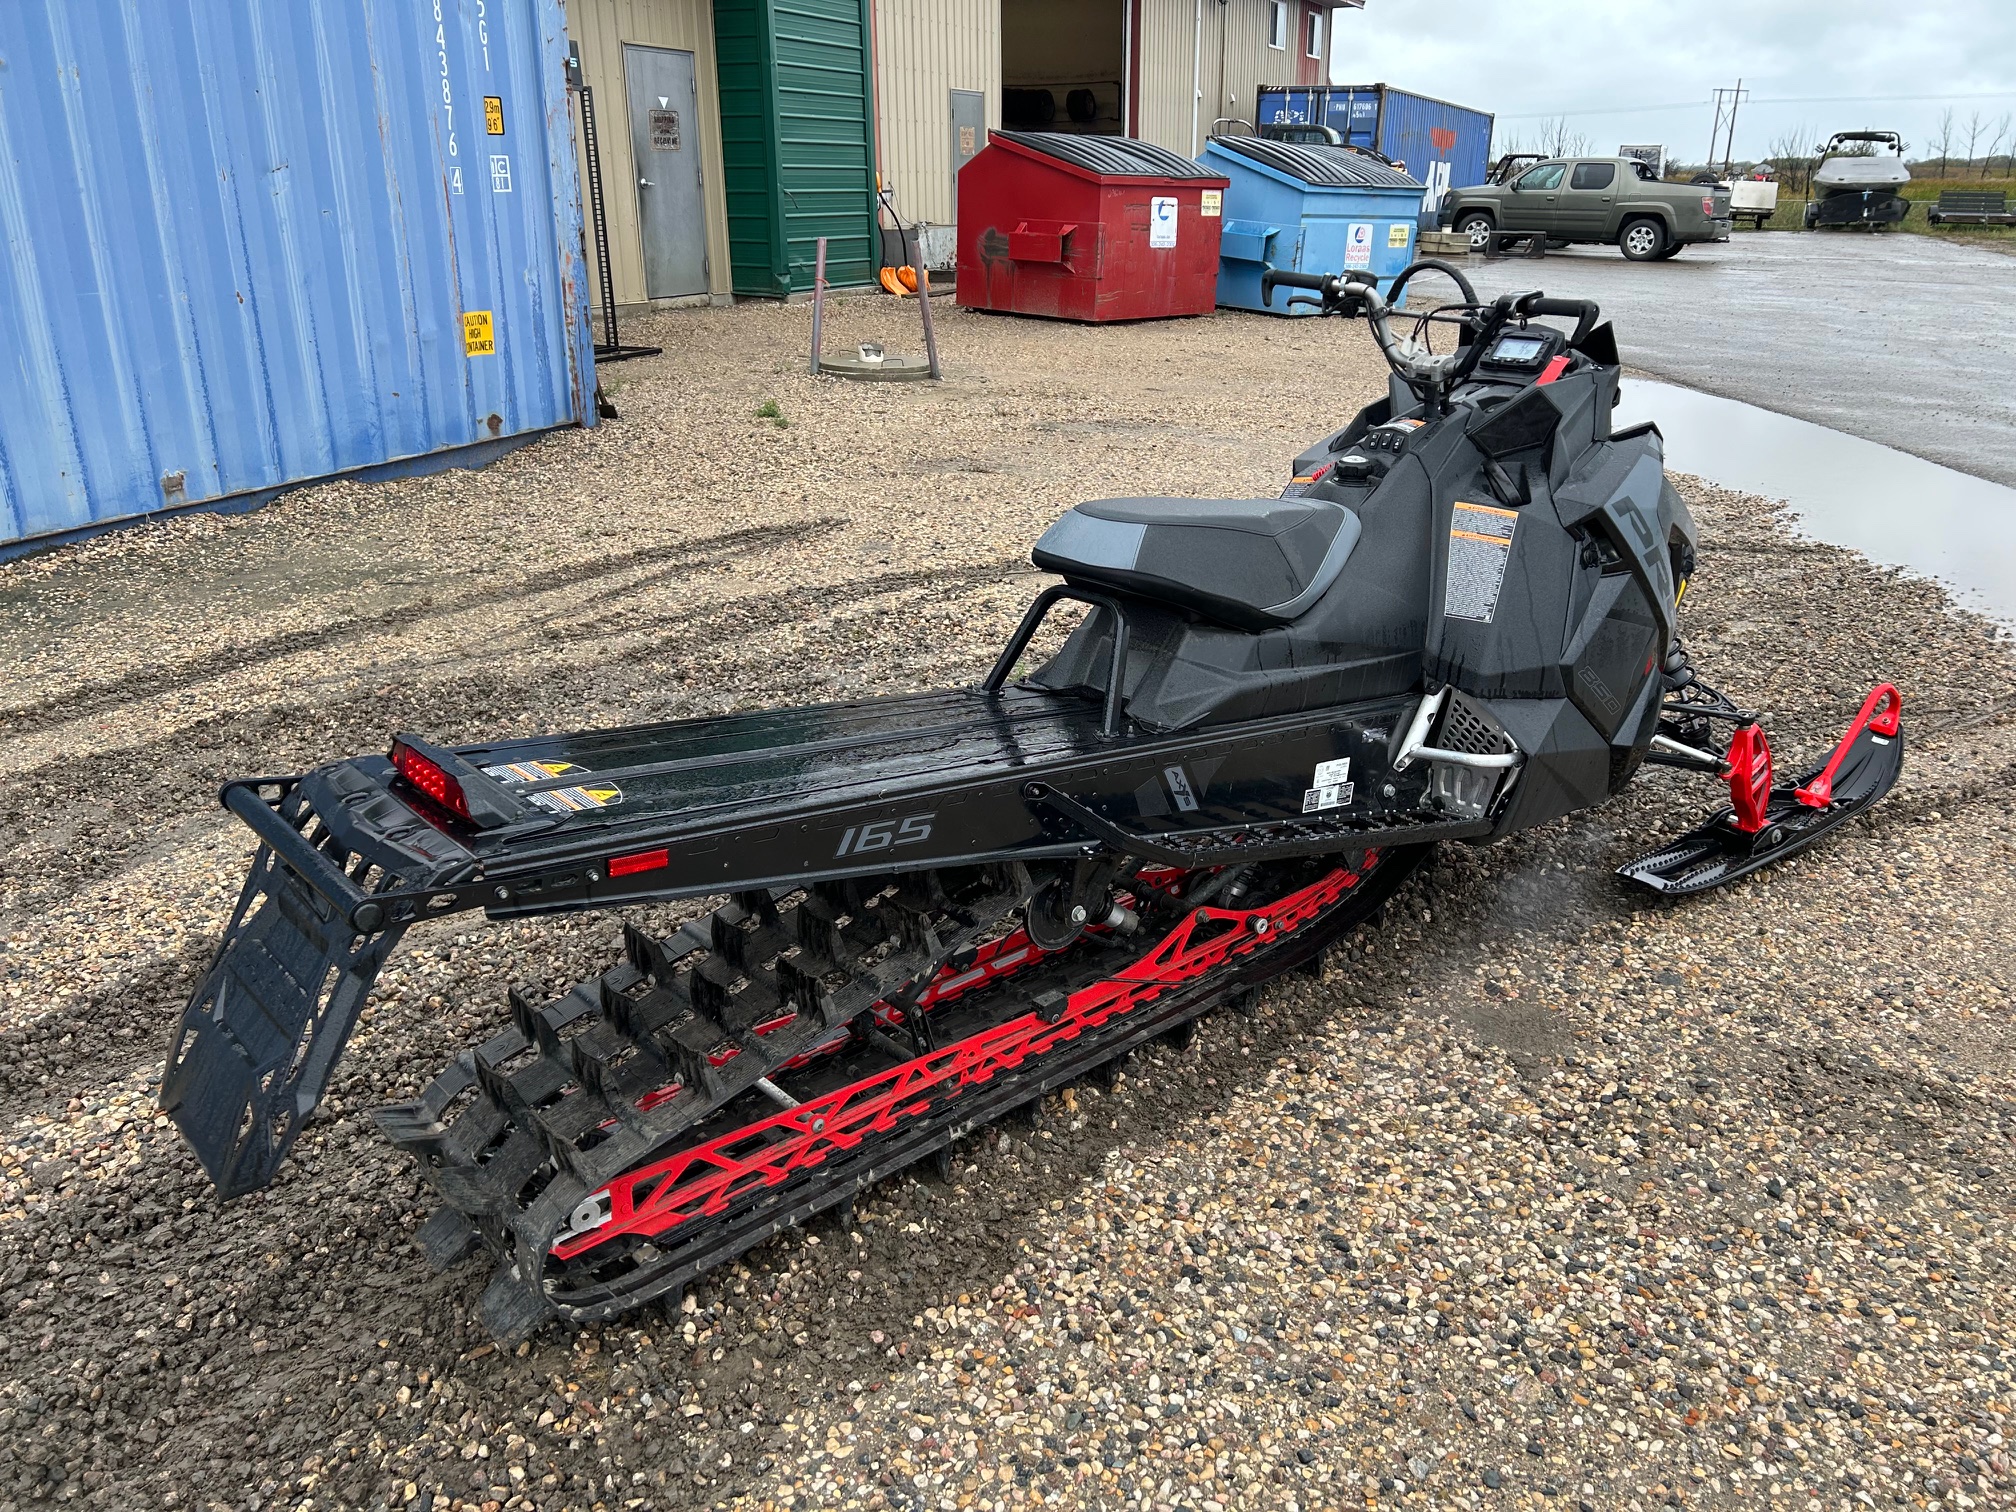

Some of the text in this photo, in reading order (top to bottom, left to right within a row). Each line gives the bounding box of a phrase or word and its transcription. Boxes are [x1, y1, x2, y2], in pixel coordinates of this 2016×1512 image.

[1346, 242, 1370, 253] Loraas
[1345, 252, 1369, 263] Recycle
[464, 314, 488, 327] CAUTION
[466, 340, 494, 354] ONTAINER
[1578, 665, 1622, 715] 850
[834, 812, 937, 857] 165
